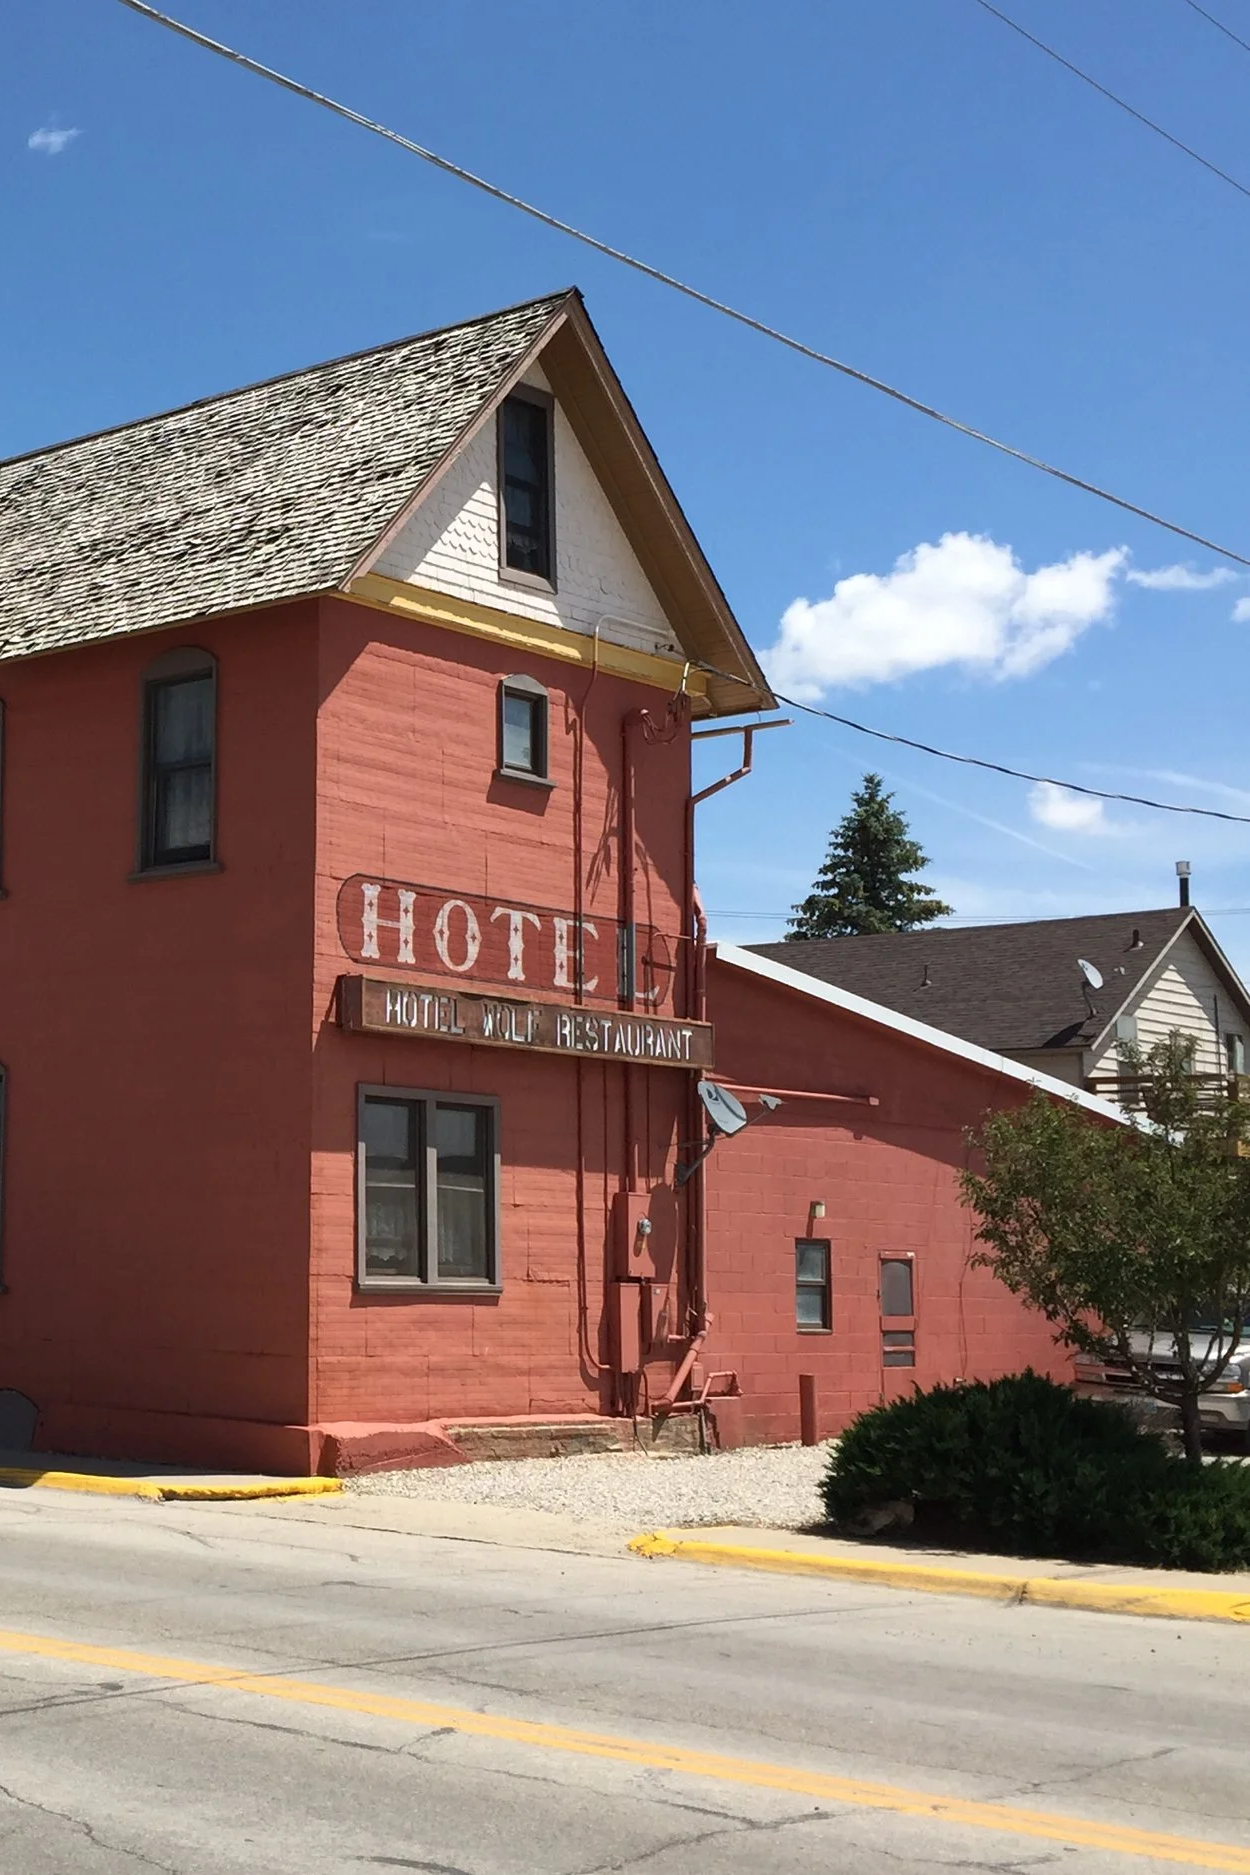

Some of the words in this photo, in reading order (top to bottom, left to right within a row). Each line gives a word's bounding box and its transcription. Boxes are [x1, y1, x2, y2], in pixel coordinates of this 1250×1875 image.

[361, 883, 660, 999] HOTEL
[386, 988, 466, 1035] HOTEL
[481, 1000, 543, 1043] WOLF
[556, 1013, 694, 1061] RESTAURANT
